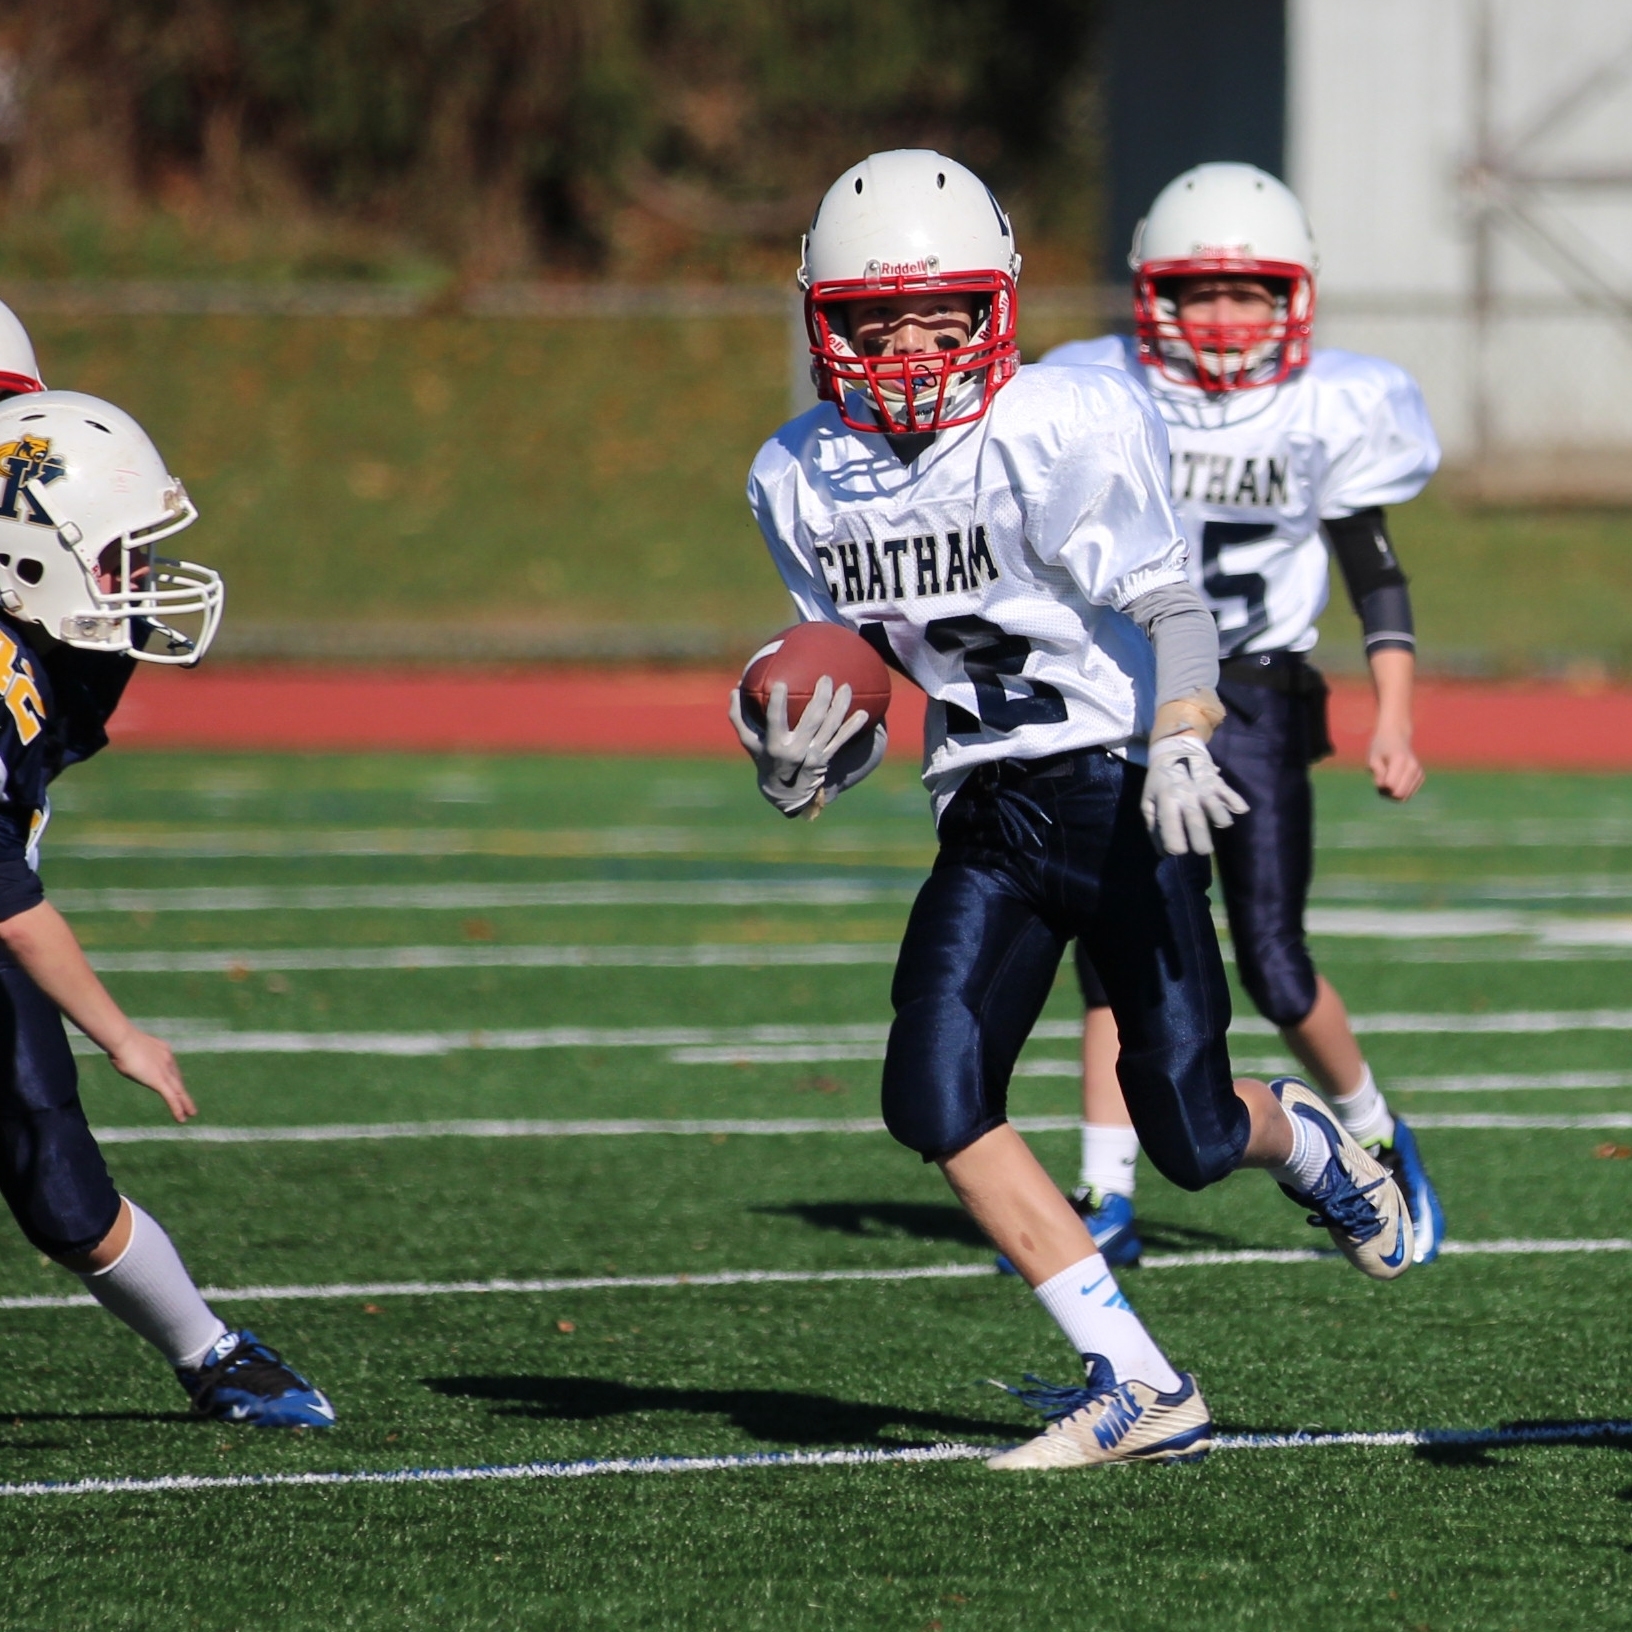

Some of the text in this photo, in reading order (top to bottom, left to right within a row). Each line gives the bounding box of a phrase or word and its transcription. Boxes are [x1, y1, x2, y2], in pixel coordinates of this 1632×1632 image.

[881, 258, 927, 275] Riddell
[0, 455, 67, 528] K
[814, 524, 999, 603] CHATHAM
[1202, 520, 1278, 657] 5
[1092, 1384, 1144, 1450] NIKE
